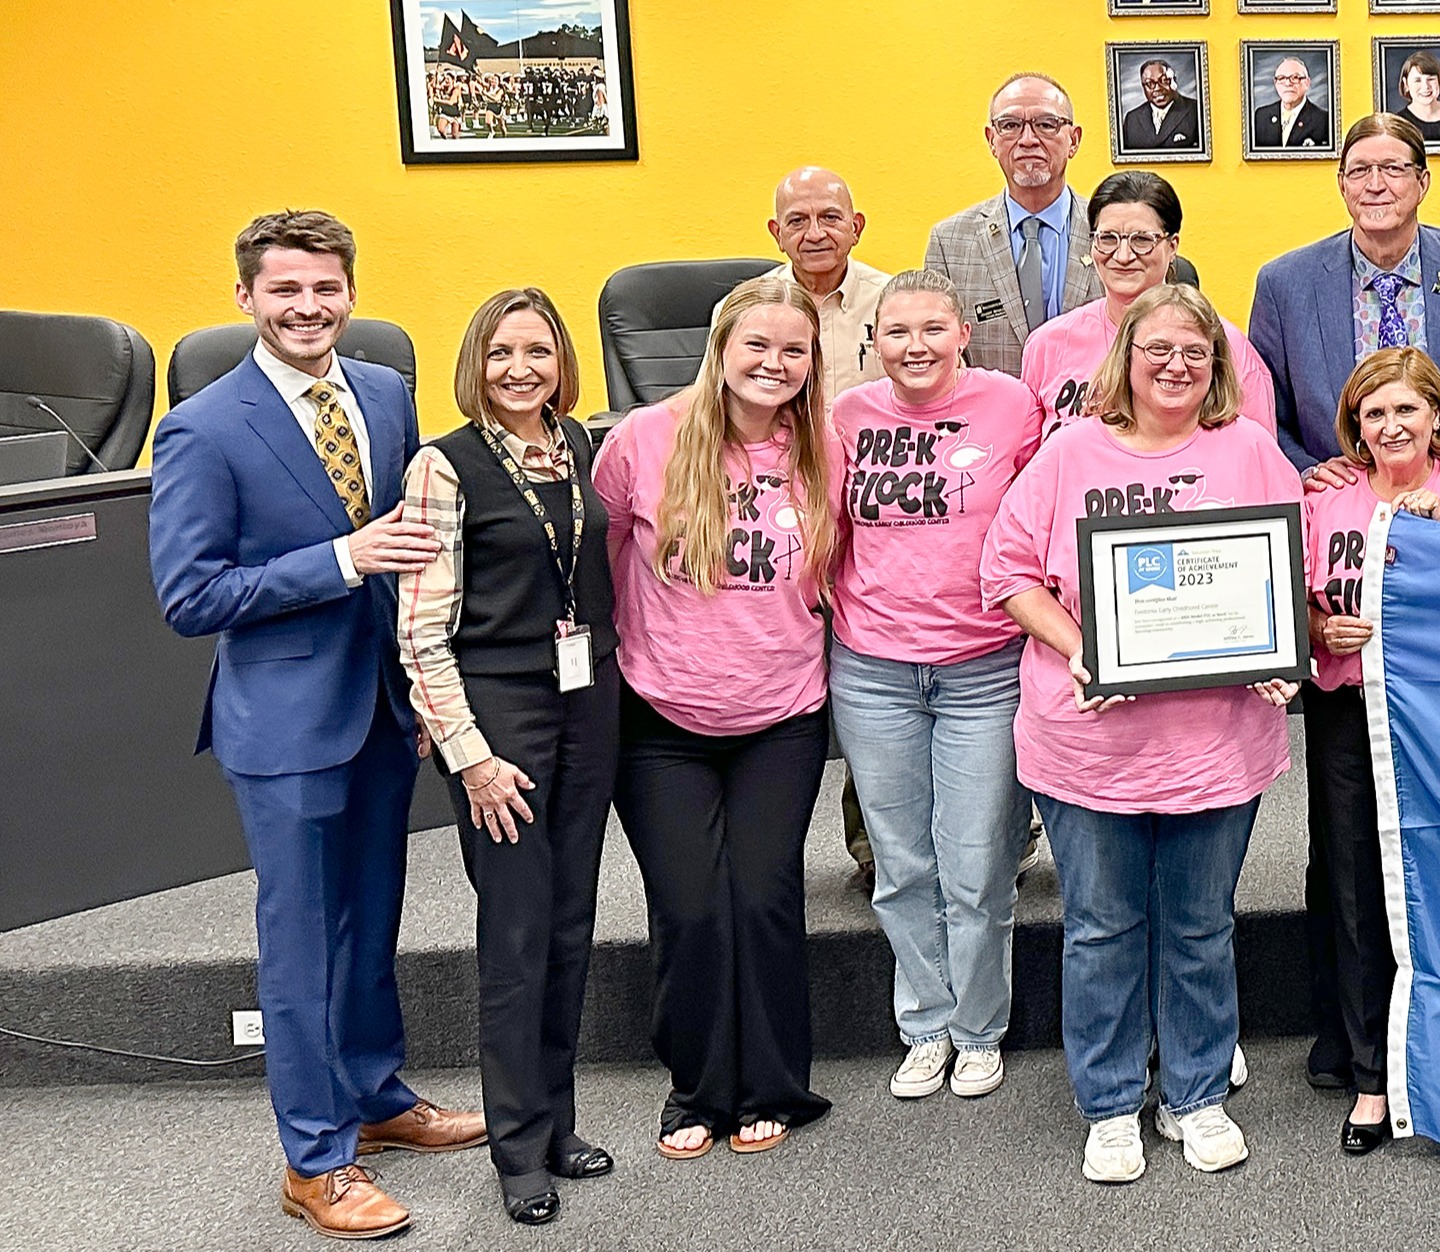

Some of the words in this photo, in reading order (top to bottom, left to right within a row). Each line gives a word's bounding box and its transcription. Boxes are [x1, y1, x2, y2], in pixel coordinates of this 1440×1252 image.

[855, 426, 936, 468] PRE-K
[851, 470, 948, 521] FLOCK
[1084, 483, 1176, 519] PRE-K
[1138, 556, 1160, 567] PLC
[1177, 556, 1220, 566] CERTIFICATE
[1177, 565, 1186, 573] OF
[1188, 562, 1238, 572] ACHIEVEMENT
[1179, 572, 1214, 587] 2023
